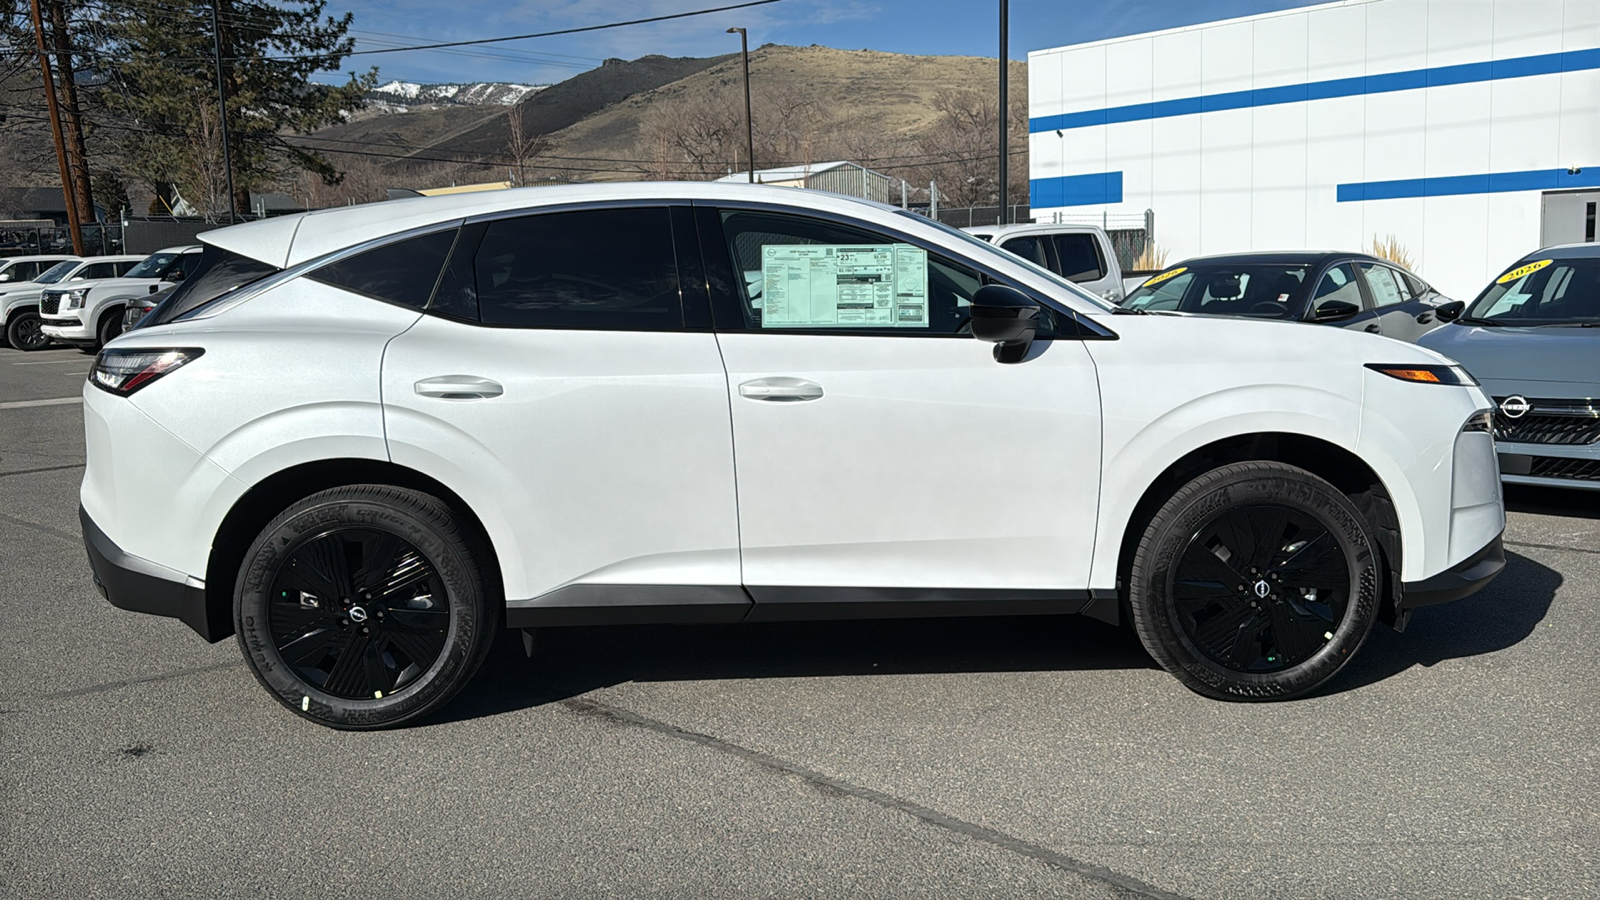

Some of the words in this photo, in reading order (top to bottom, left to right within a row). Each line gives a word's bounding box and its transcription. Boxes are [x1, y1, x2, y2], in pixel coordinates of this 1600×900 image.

[1507, 263, 1541, 280] 2026
[356, 508, 422, 534] CRUGEN
[245, 615, 277, 673] KUMHO
